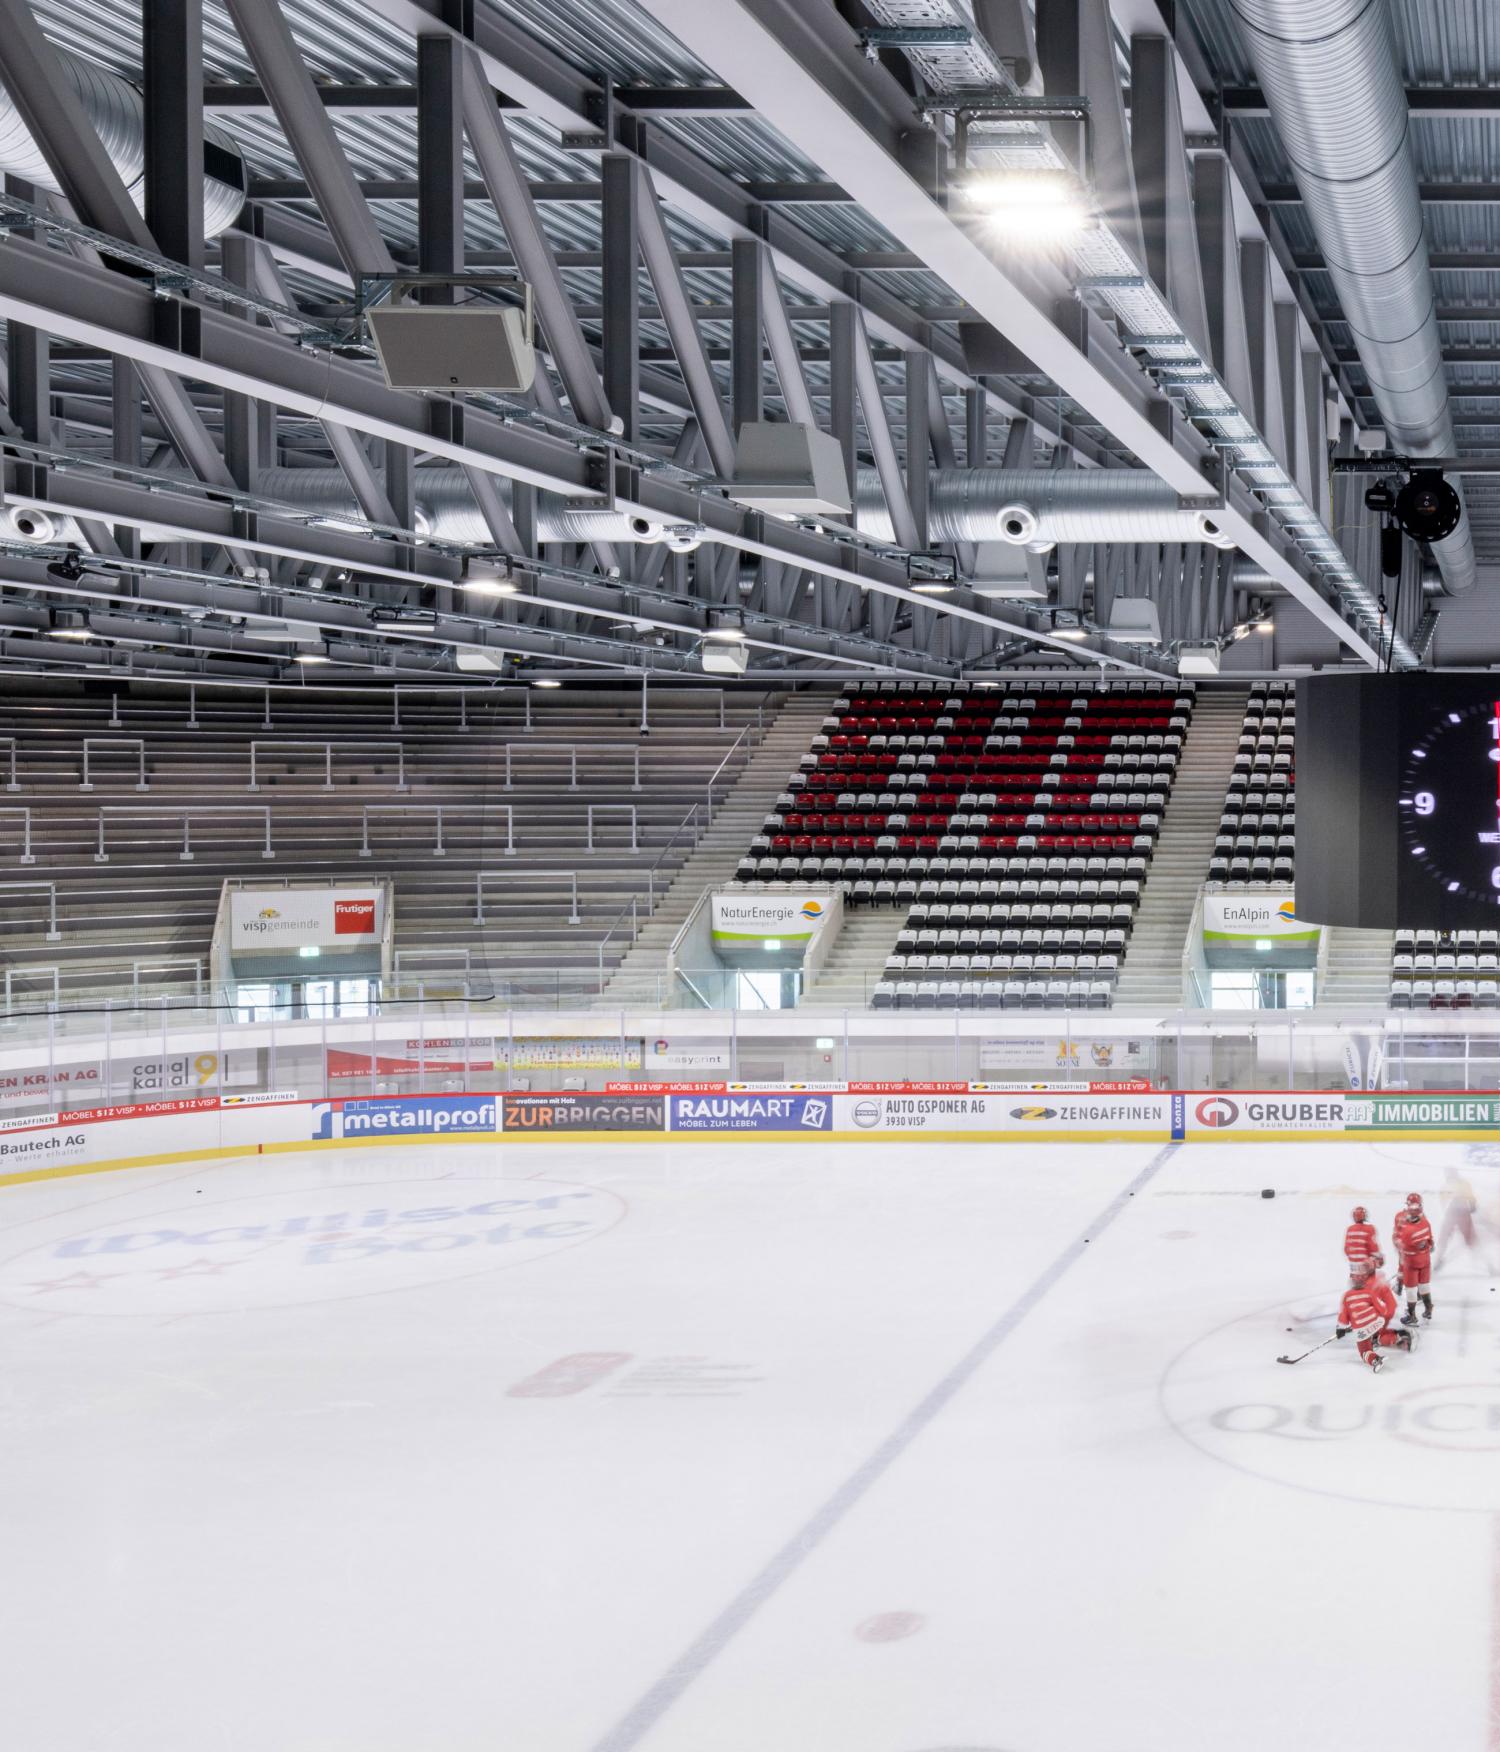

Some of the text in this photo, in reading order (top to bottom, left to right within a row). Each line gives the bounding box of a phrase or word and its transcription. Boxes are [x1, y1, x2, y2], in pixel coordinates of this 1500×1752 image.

[1414, 792, 1435, 815] 9
[336, 904, 373, 914] Frutiger
[721, 907, 794, 921] NaturEnergie
[1224, 908, 1270, 923] EnAlpin
[75, 1070, 97, 1080] AG
[194, 1054, 218, 1085] 9
[609, 1083, 633, 1091] MÖBEL
[670, 1083, 694, 1091] MÖBEL
[247, 1094, 294, 1102] ZENGAFFINEN
[146, 1104, 177, 1112] MÖBEL
[198, 1099, 216, 1107] VISP
[678, 1099, 794, 1118] RAUMART
[886, 1100, 985, 1113] AUTO GSPONER AG
[62, 1111, 94, 1121] MÖBEL
[116, 1106, 135, 1115] VISP
[344, 1104, 495, 1132] metallprofi
[505, 1106, 663, 1127] ZURBRIGGEN
[1060, 1107, 1162, 1120] ZENGAFFINEN
[1248, 1104, 1343, 1121] GRUBER
[1378, 1104, 1489, 1122] IMMOBILIEN
[2, 1117, 55, 1129] ZENGAFFINEN
[680, 1119, 757, 1128] MÖBEL ZUM LEBEN
[886, 1117, 926, 1126] 3930 VISP
[0, 1134, 86, 1155] Bautech AG
